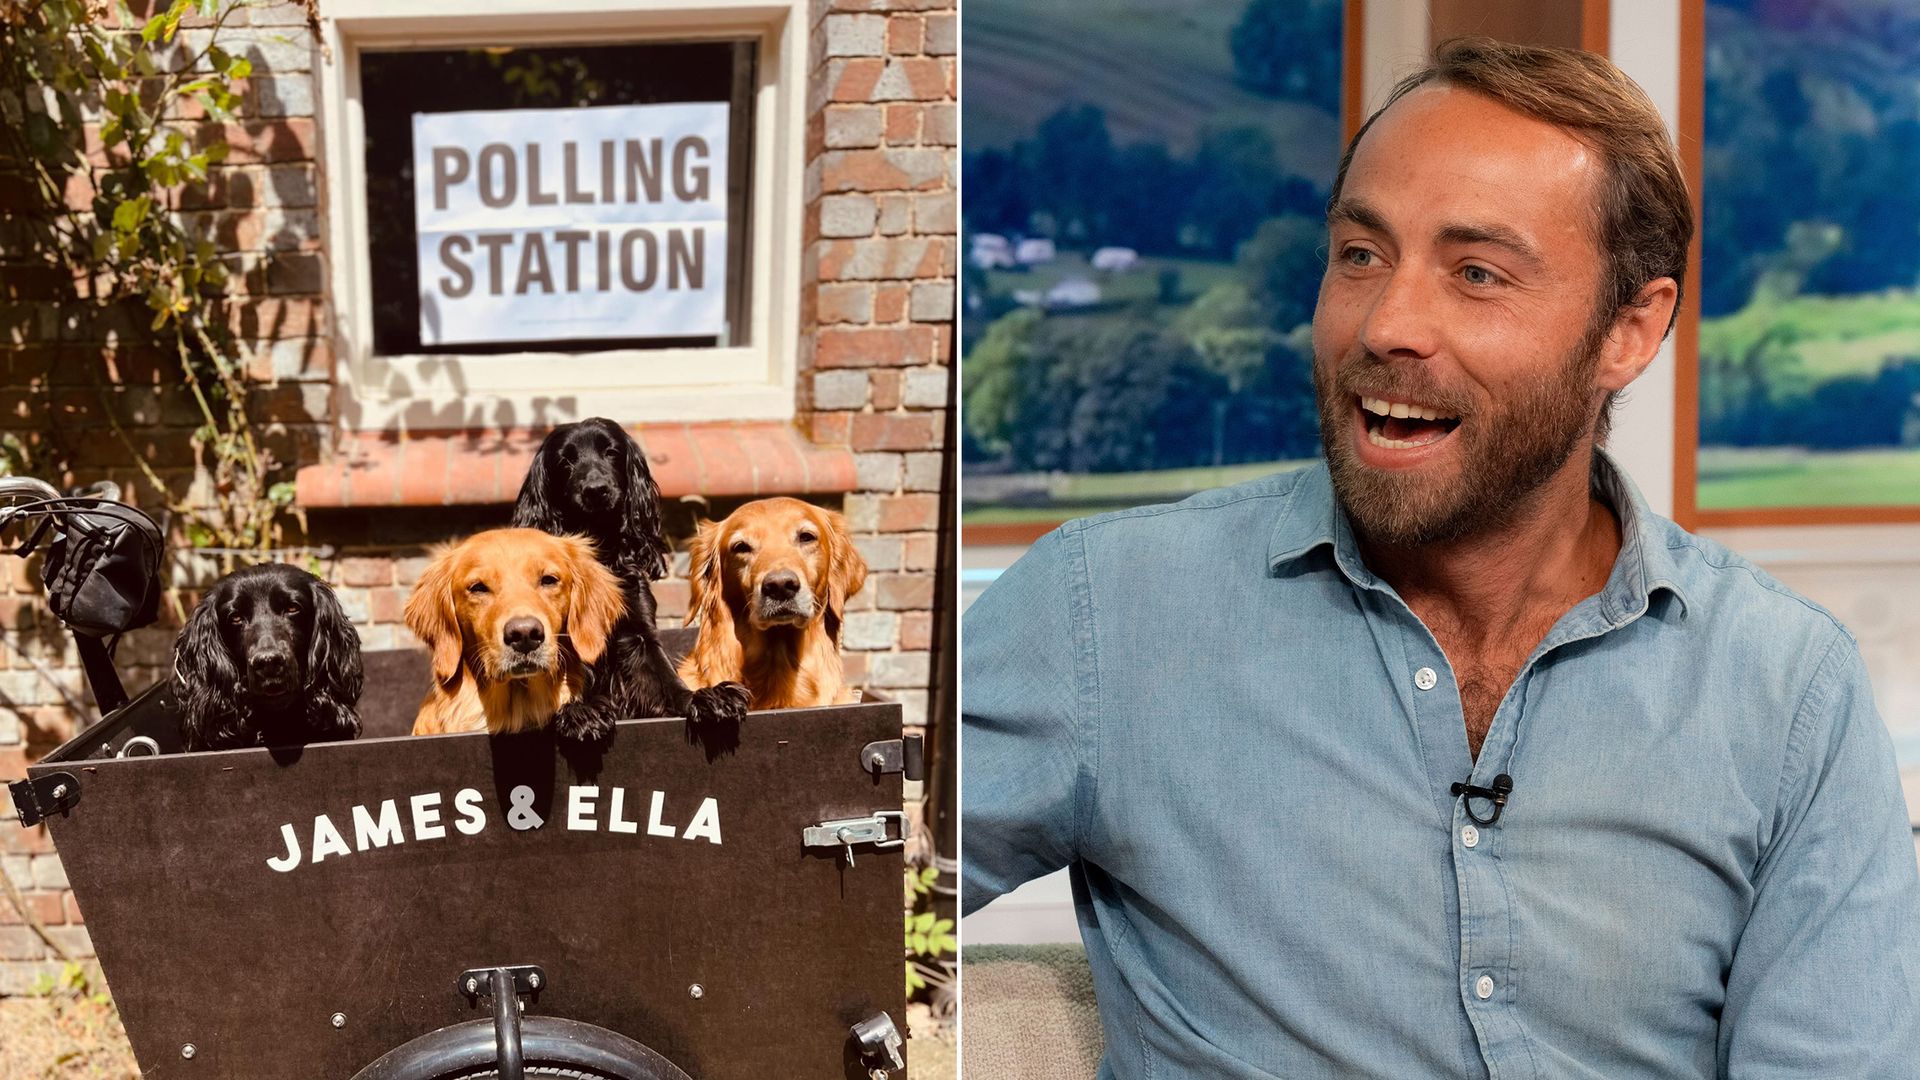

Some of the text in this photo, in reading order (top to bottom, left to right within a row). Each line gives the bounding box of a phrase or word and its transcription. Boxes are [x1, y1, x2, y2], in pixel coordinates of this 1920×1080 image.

[431, 135, 711, 211] POLLING
[437, 227, 706, 299] STATION
[265, 784, 723, 873] JAMES & ELLA
